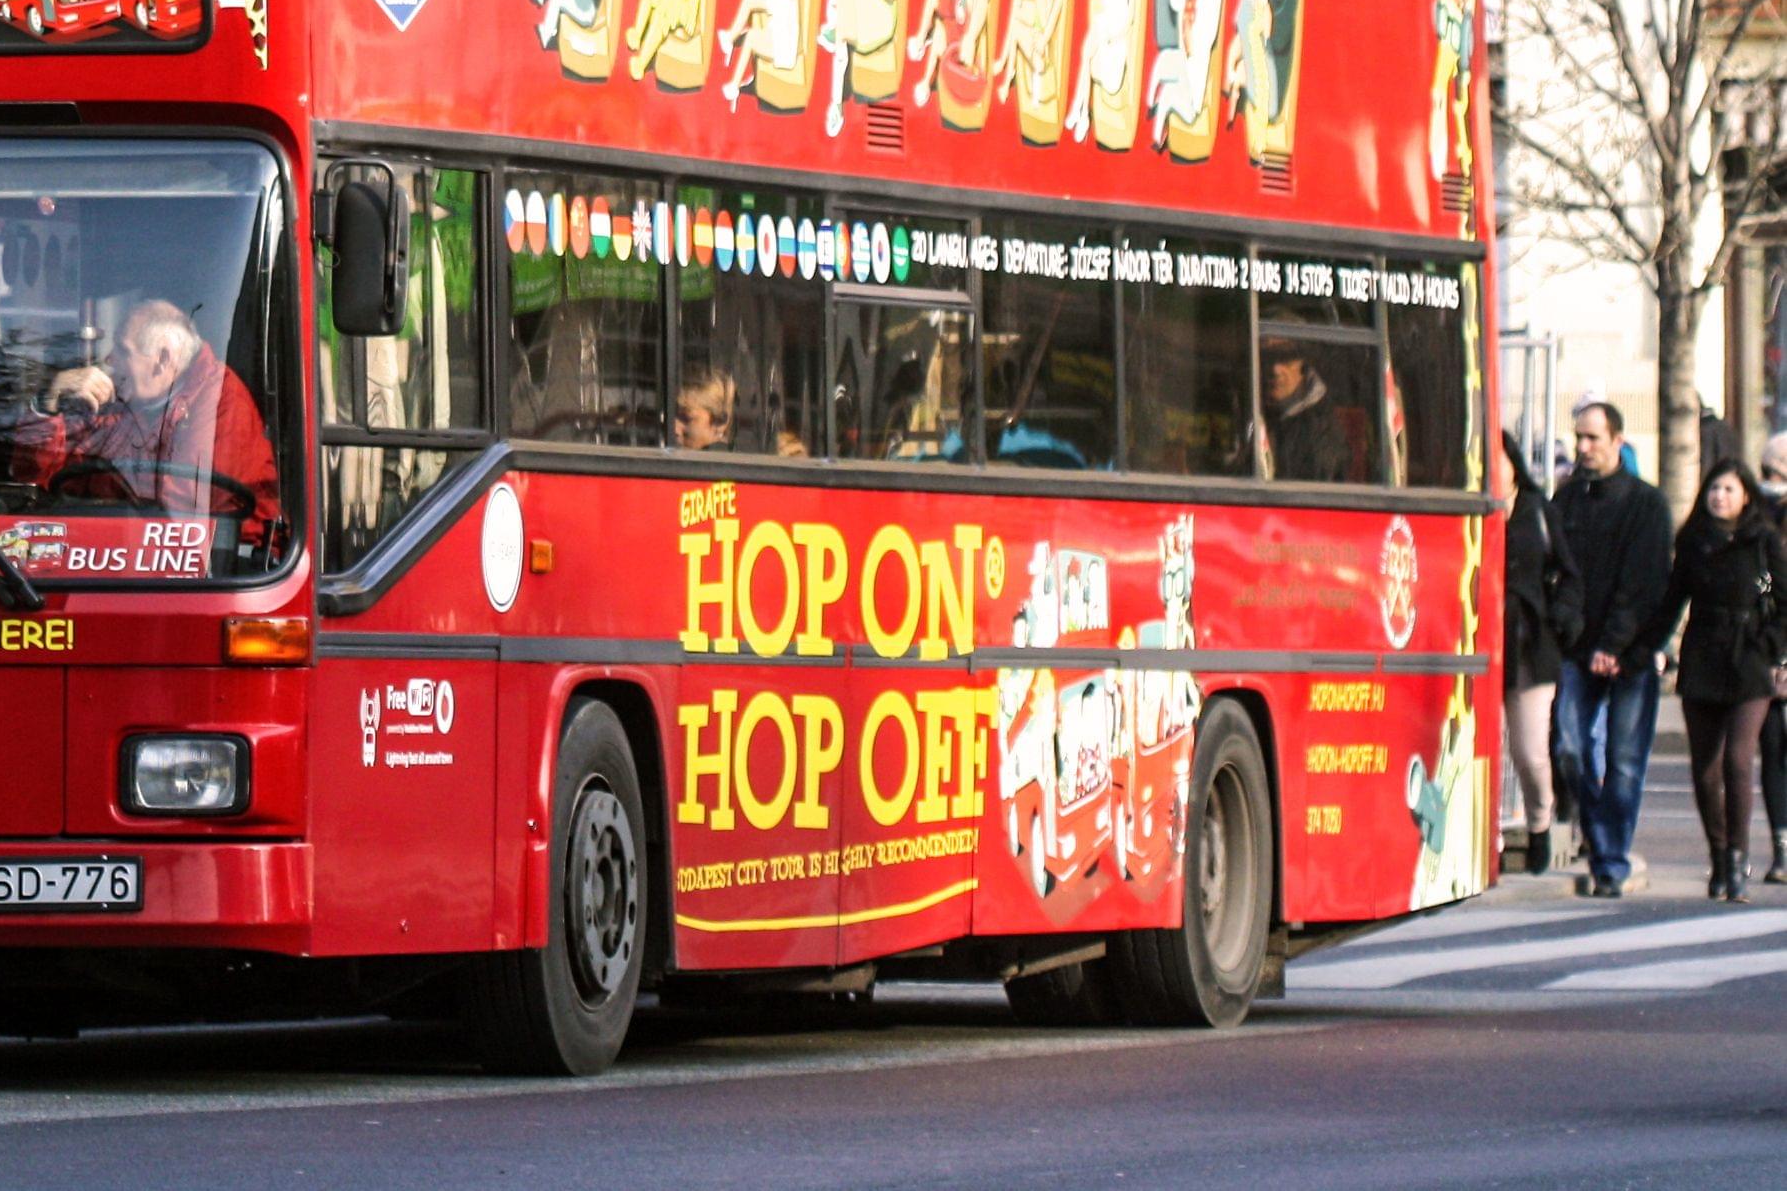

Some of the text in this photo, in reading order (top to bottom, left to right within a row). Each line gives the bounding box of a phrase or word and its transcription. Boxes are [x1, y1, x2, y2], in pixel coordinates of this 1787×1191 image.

[1239, 257, 1249, 289] 2
[679, 482, 736, 529] GIRAFFE
[143, 521, 206, 547] RED
[67, 548, 202, 572] BUS LINE
[679, 519, 983, 661] HOP ON
[386, 684, 407, 710] Free
[677, 687, 999, 830] HOP OFF
[737, 860, 769, 885] CITY
[771, 855, 805, 881] TOUR
[809, 852, 822, 878] IS
[876, 827, 980, 866] RECOMMENDED!
